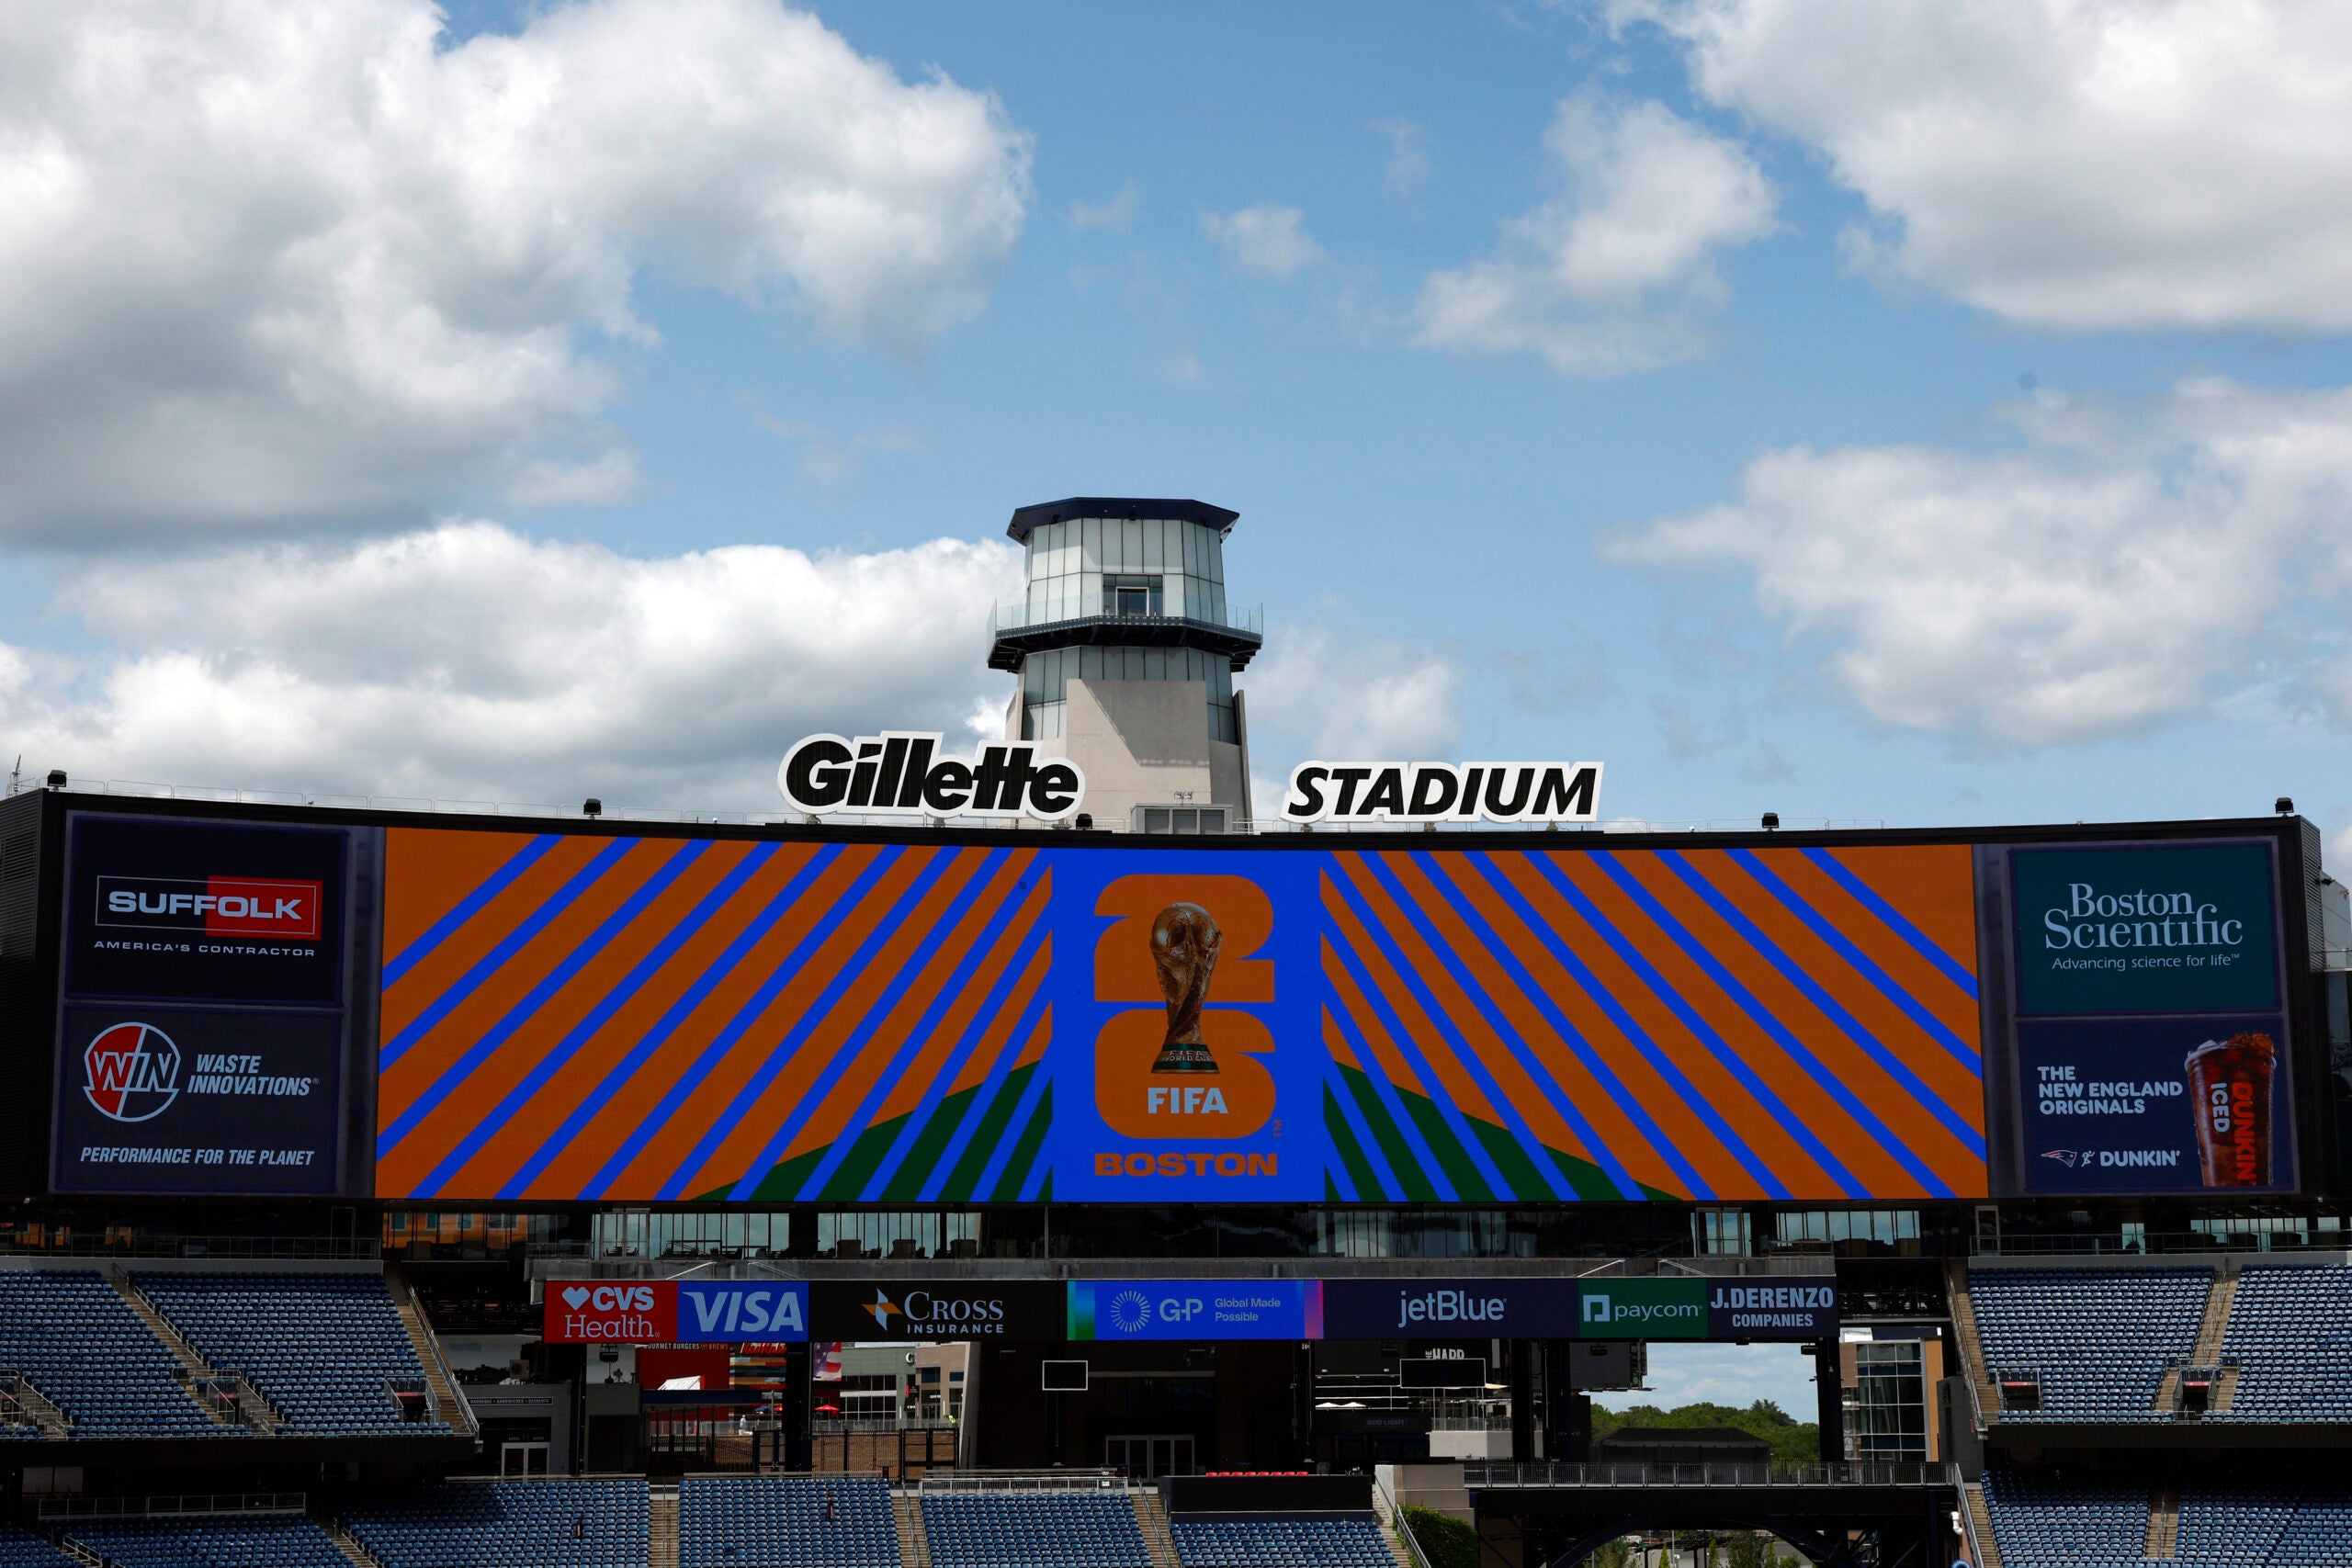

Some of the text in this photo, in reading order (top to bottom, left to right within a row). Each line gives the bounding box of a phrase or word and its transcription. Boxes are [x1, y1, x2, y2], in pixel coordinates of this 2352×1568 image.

[785, 738, 1597, 817] Gillette STADIUM
[108, 890, 302, 919] SUFFOLK
[2068, 883, 2195, 918] Boston
[2044, 903, 2243, 949] Scientific
[94, 941, 315, 956] AMERICA'S CONTRACTOR
[2052, 957, 2126, 972] Advancing
[2132, 956, 2181, 967] science
[2186, 954, 2206, 967] for
[197, 1055, 262, 1074] WASTE
[2038, 1066, 2076, 1081] THE
[2039, 1082, 2183, 1098] NEW ENGLAND
[1148, 1087, 1228, 1114] FIFA
[2040, 1099, 2146, 1115] ORIGINALS
[2210, 1082, 2231, 1133] ICED
[80, 1147, 314, 1166] PERFORMANCE FOR THE PLANET
[1094, 1153, 1278, 1177] BOSTON
[2099, 1150, 2180, 1167] DUNKIN'
[592, 1286, 655, 1312] CVS
[1215, 1297, 1281, 1308] Global Made
[1710, 1287, 1834, 1309] J.DERENZO
[682, 1291, 804, 1333] VISA
[1215, 1312, 1259, 1322] Possible
[1732, 1314, 1814, 1327] COMPANIES
[907, 1324, 1004, 1334] INSURANCE
